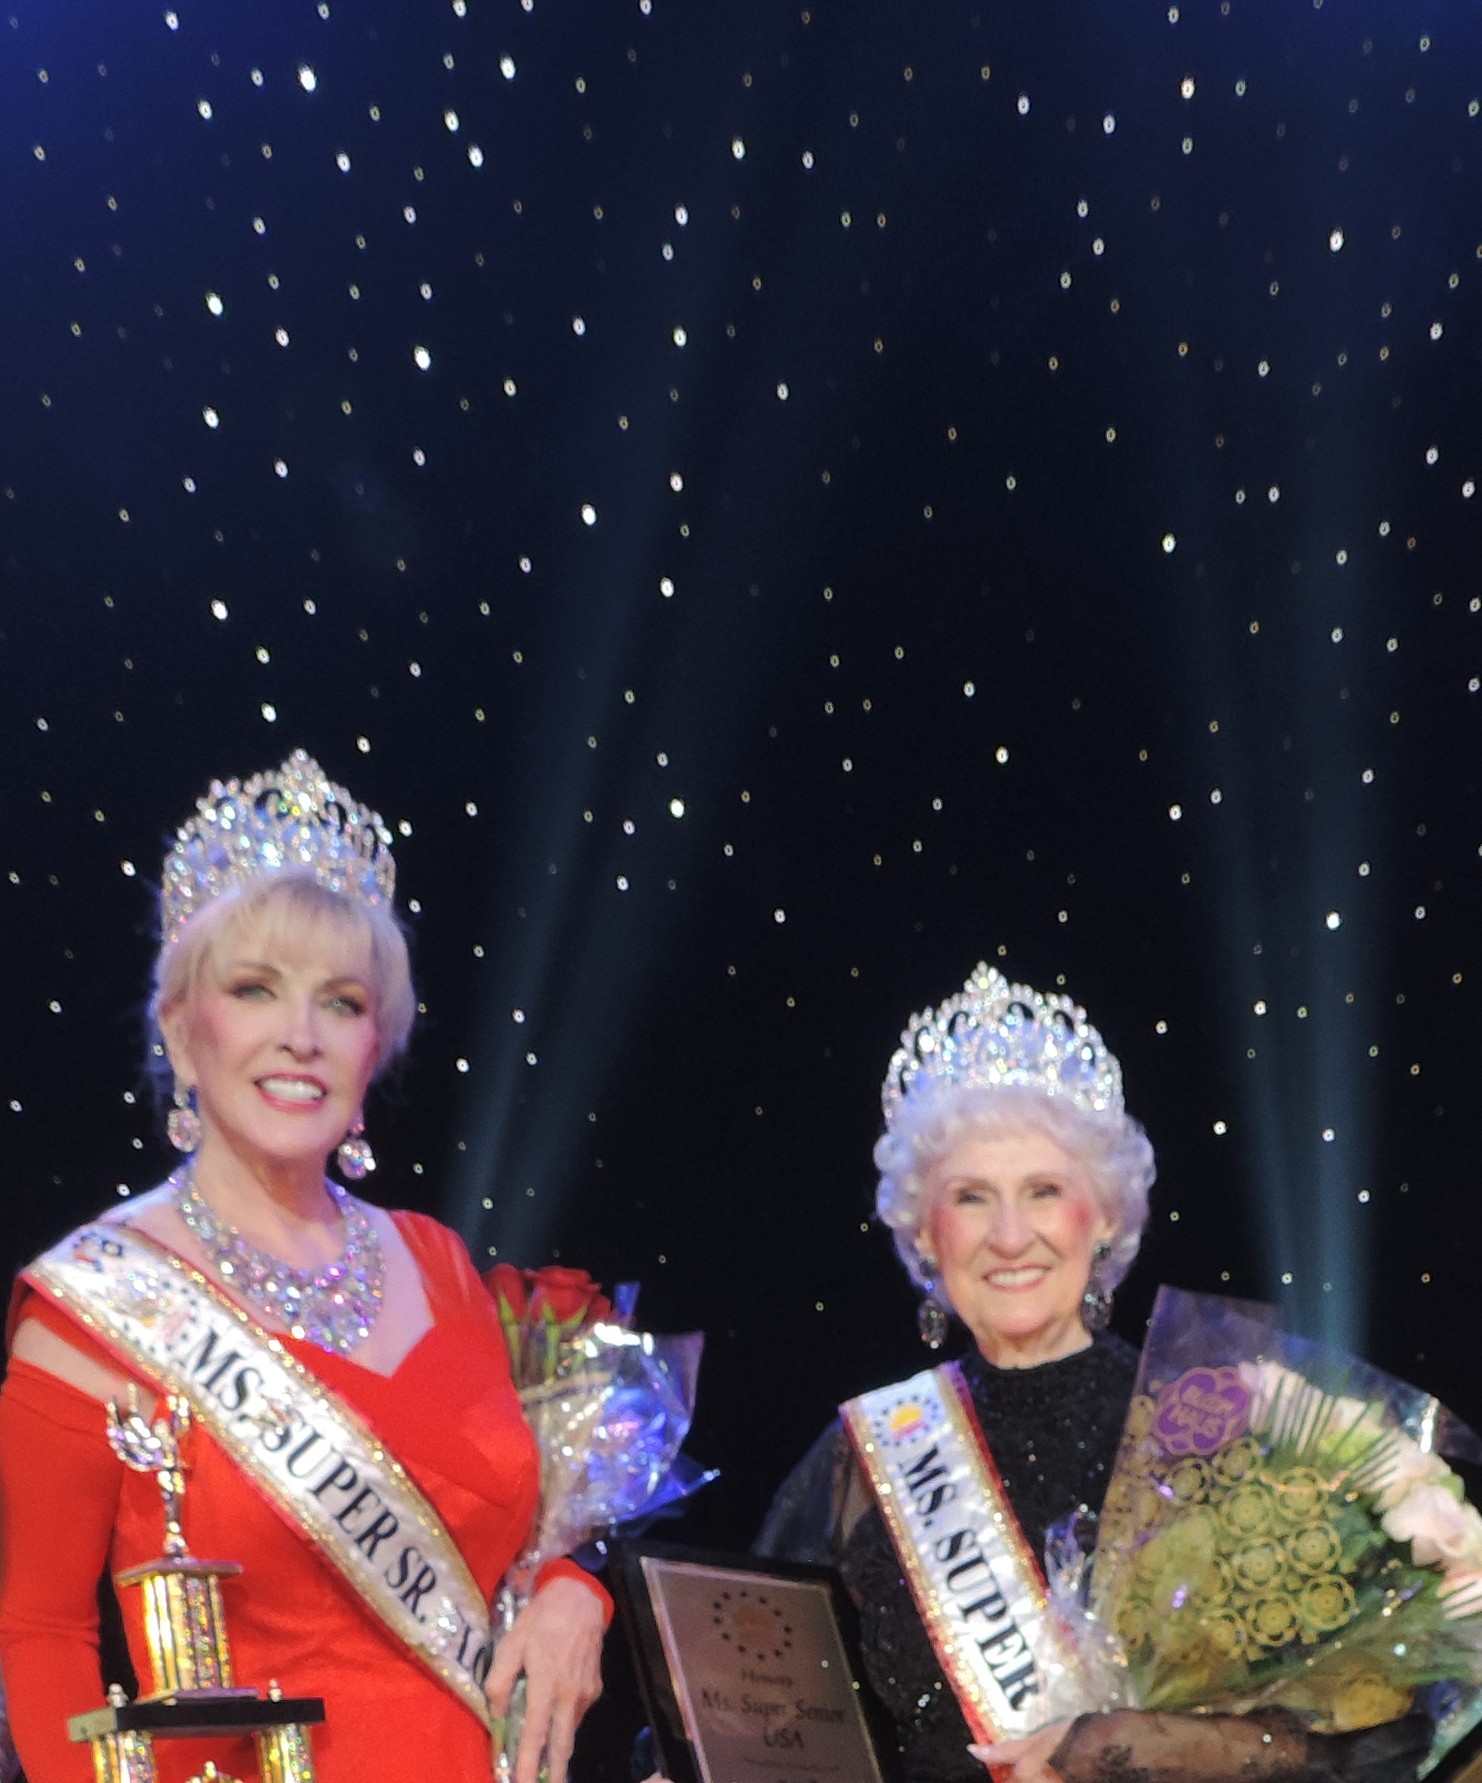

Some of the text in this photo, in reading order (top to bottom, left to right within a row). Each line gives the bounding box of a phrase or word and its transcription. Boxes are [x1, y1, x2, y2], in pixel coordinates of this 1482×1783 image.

[181, 1329, 440, 1624] MS. SUPER SR.
[900, 1444, 957, 1528] MS.
[934, 1529, 1039, 1711] SUPER
